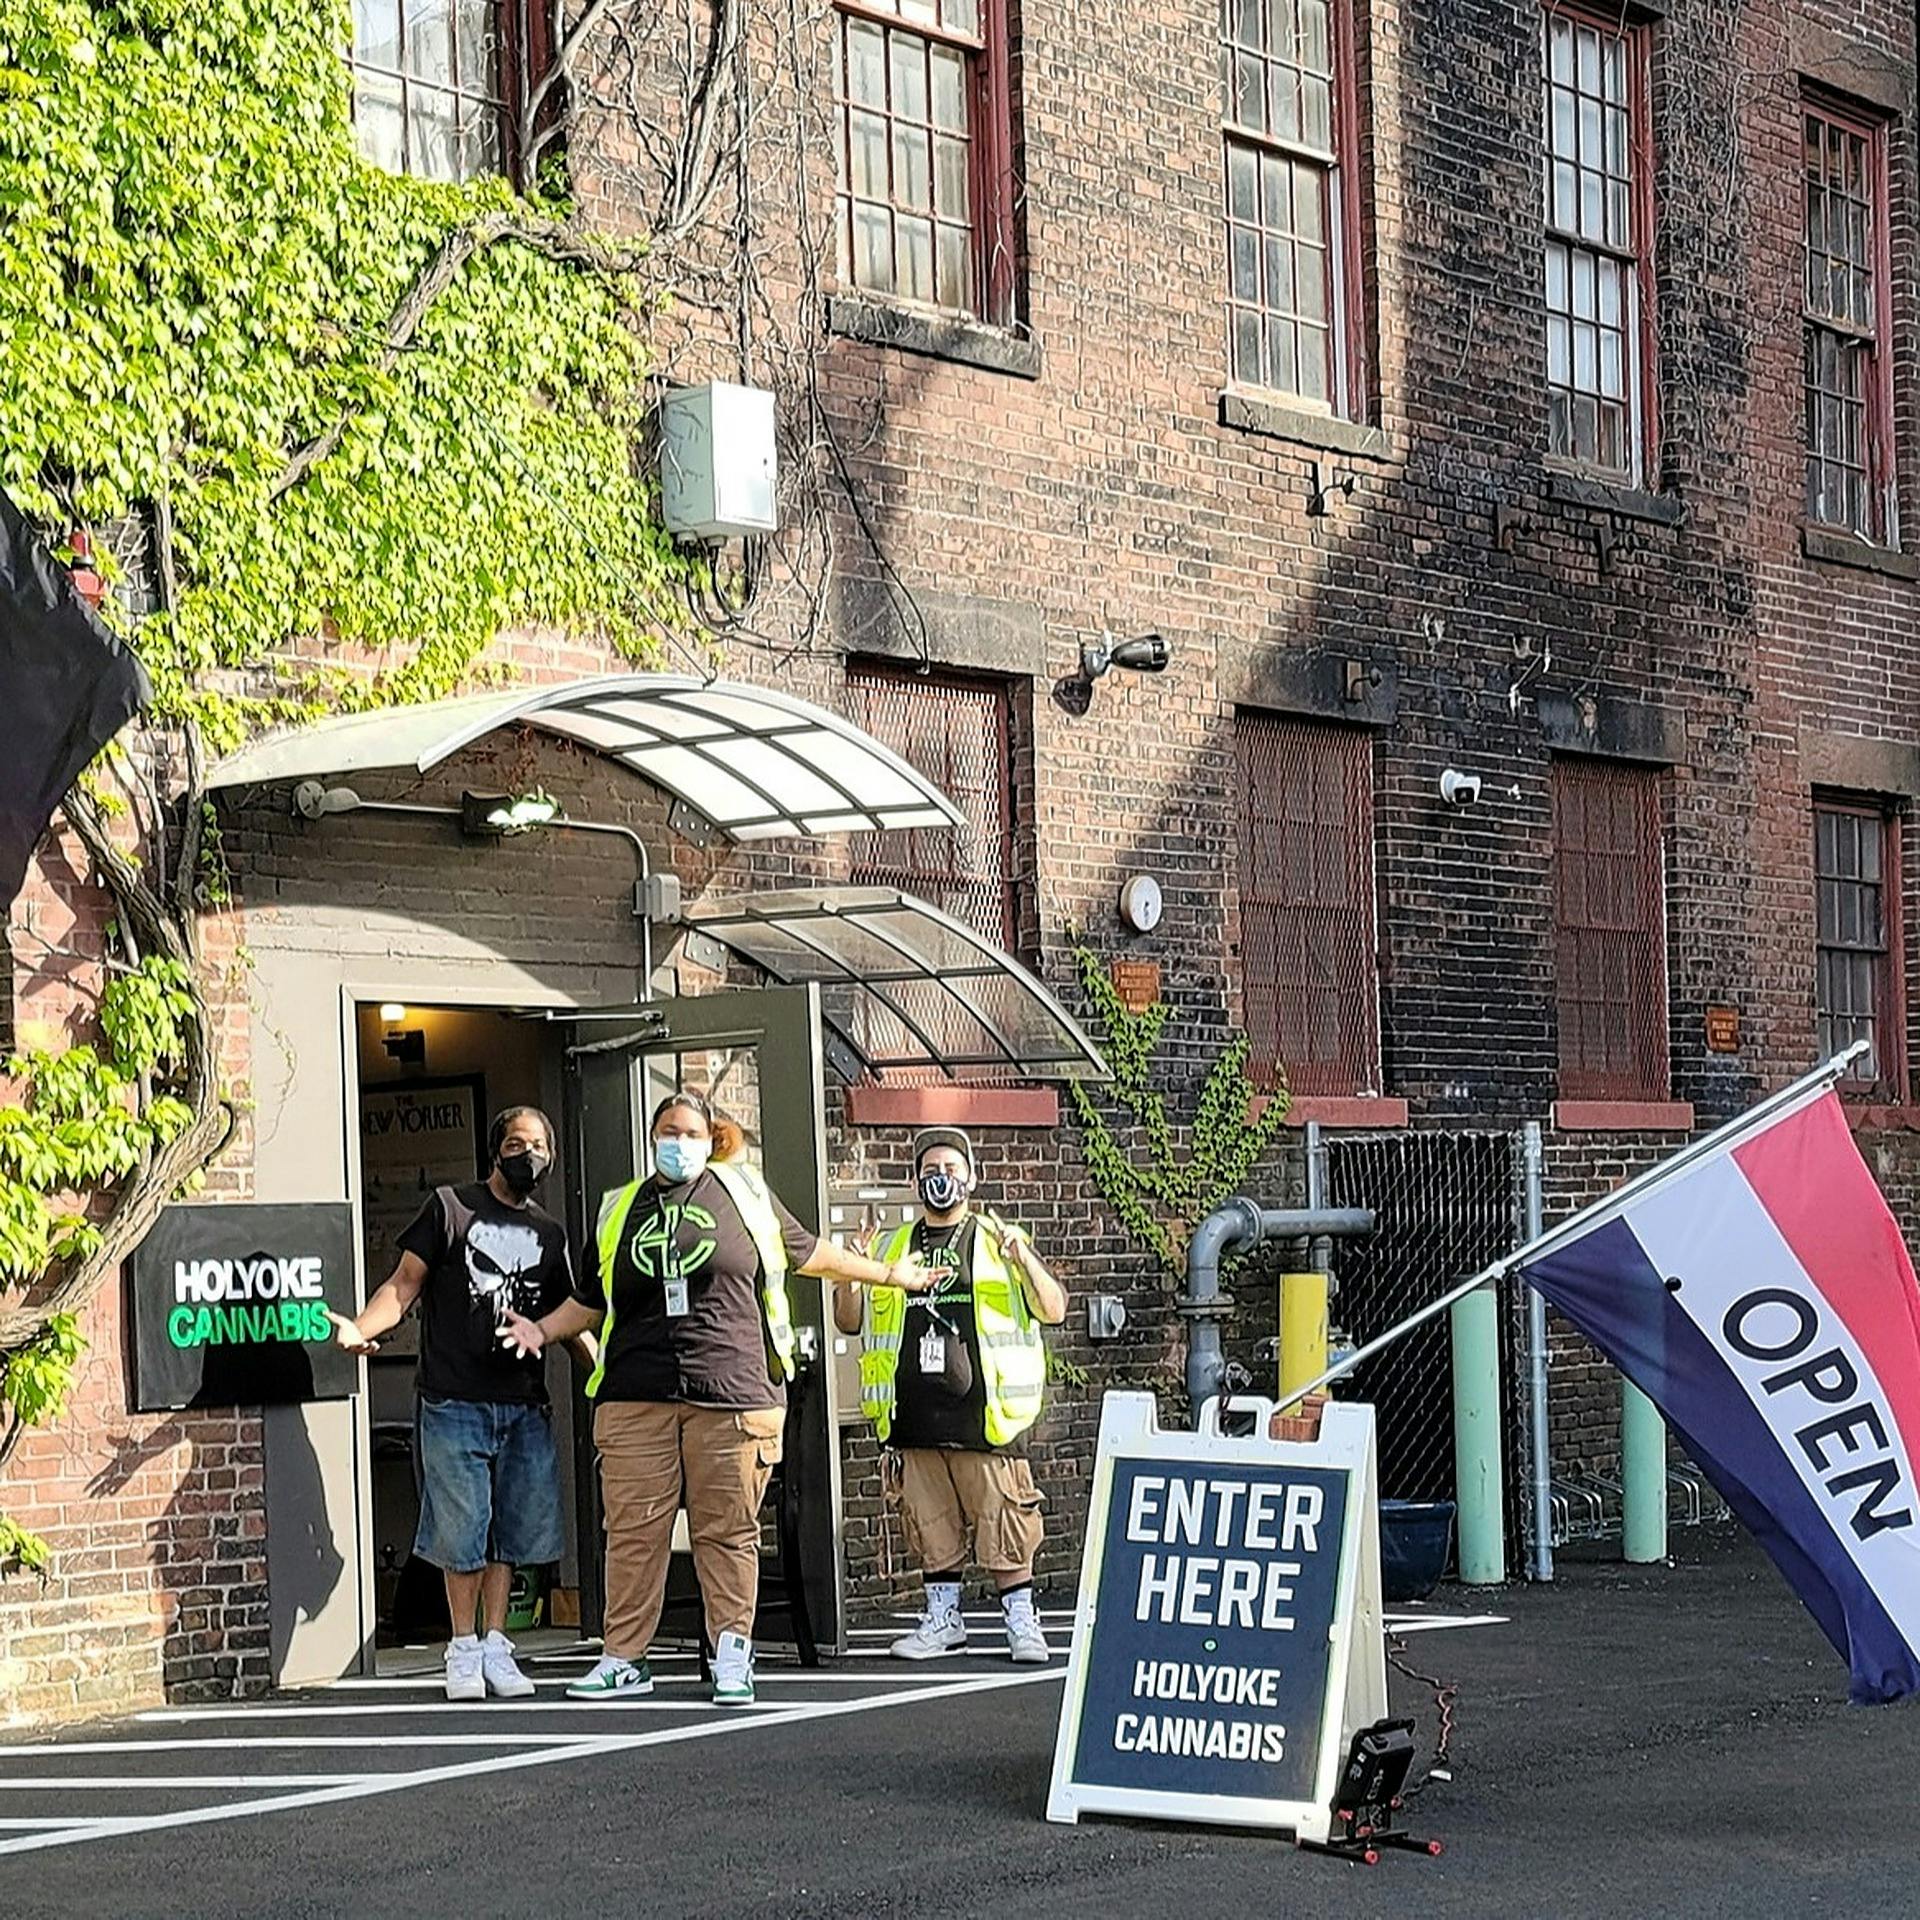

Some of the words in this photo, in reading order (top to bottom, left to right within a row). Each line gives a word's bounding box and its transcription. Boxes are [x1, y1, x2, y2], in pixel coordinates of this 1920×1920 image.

[364, 1109, 394, 1135] EW
[396, 1103, 465, 1133] YORKER
[174, 1256, 324, 1303] HOLYOKE
[168, 1301, 332, 1349] CANNABIS
[1722, 1287, 1914, 1542] OPEN
[1126, 1475, 1324, 1552] ENTER
[1135, 1553, 1301, 1631] HERE
[1133, 1660, 1281, 1707] HOLYOKE
[1114, 1713, 1286, 1762] CANNABIS
